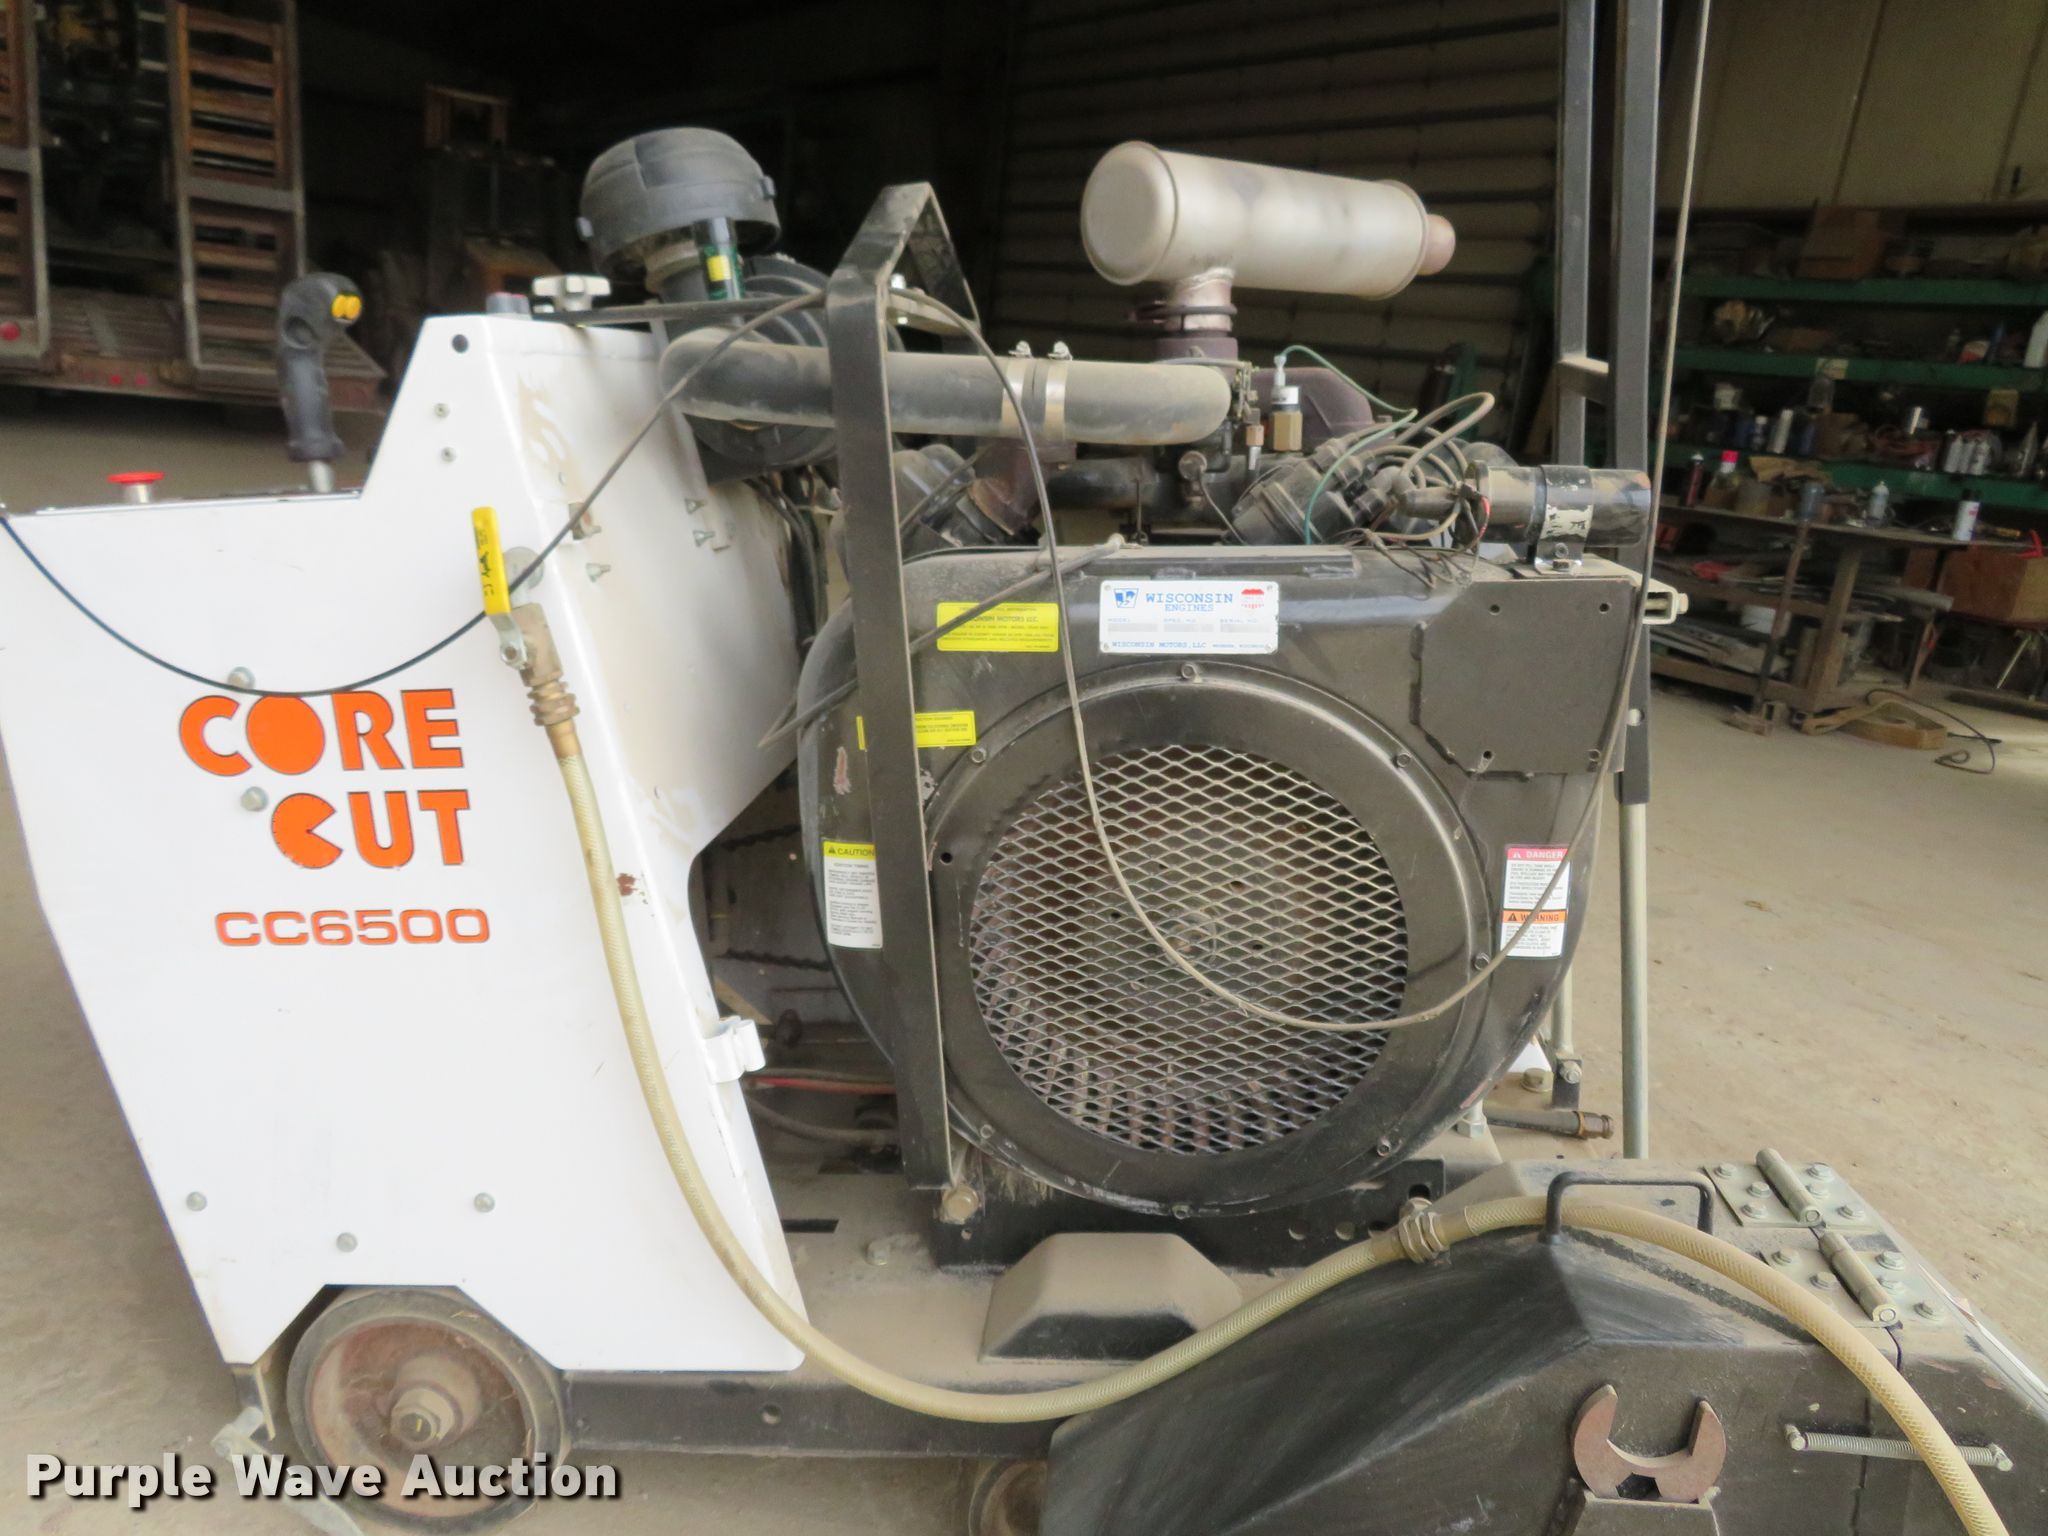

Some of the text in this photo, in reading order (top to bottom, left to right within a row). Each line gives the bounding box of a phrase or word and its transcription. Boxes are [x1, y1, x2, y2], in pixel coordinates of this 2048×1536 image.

[1145, 593, 1233, 604] WISCONSIN
[1165, 603, 1214, 612] ENGINES
[1112, 641, 1155, 649] WISCONSIN
[179, 688, 464, 776] CORE
[271, 789, 470, 869] CUT
[837, 847, 875, 857] CAUTION
[1526, 850, 1564, 859] DANGER
[1520, 913, 1560, 922] WNING
[215, 908, 490, 946] CC6500
